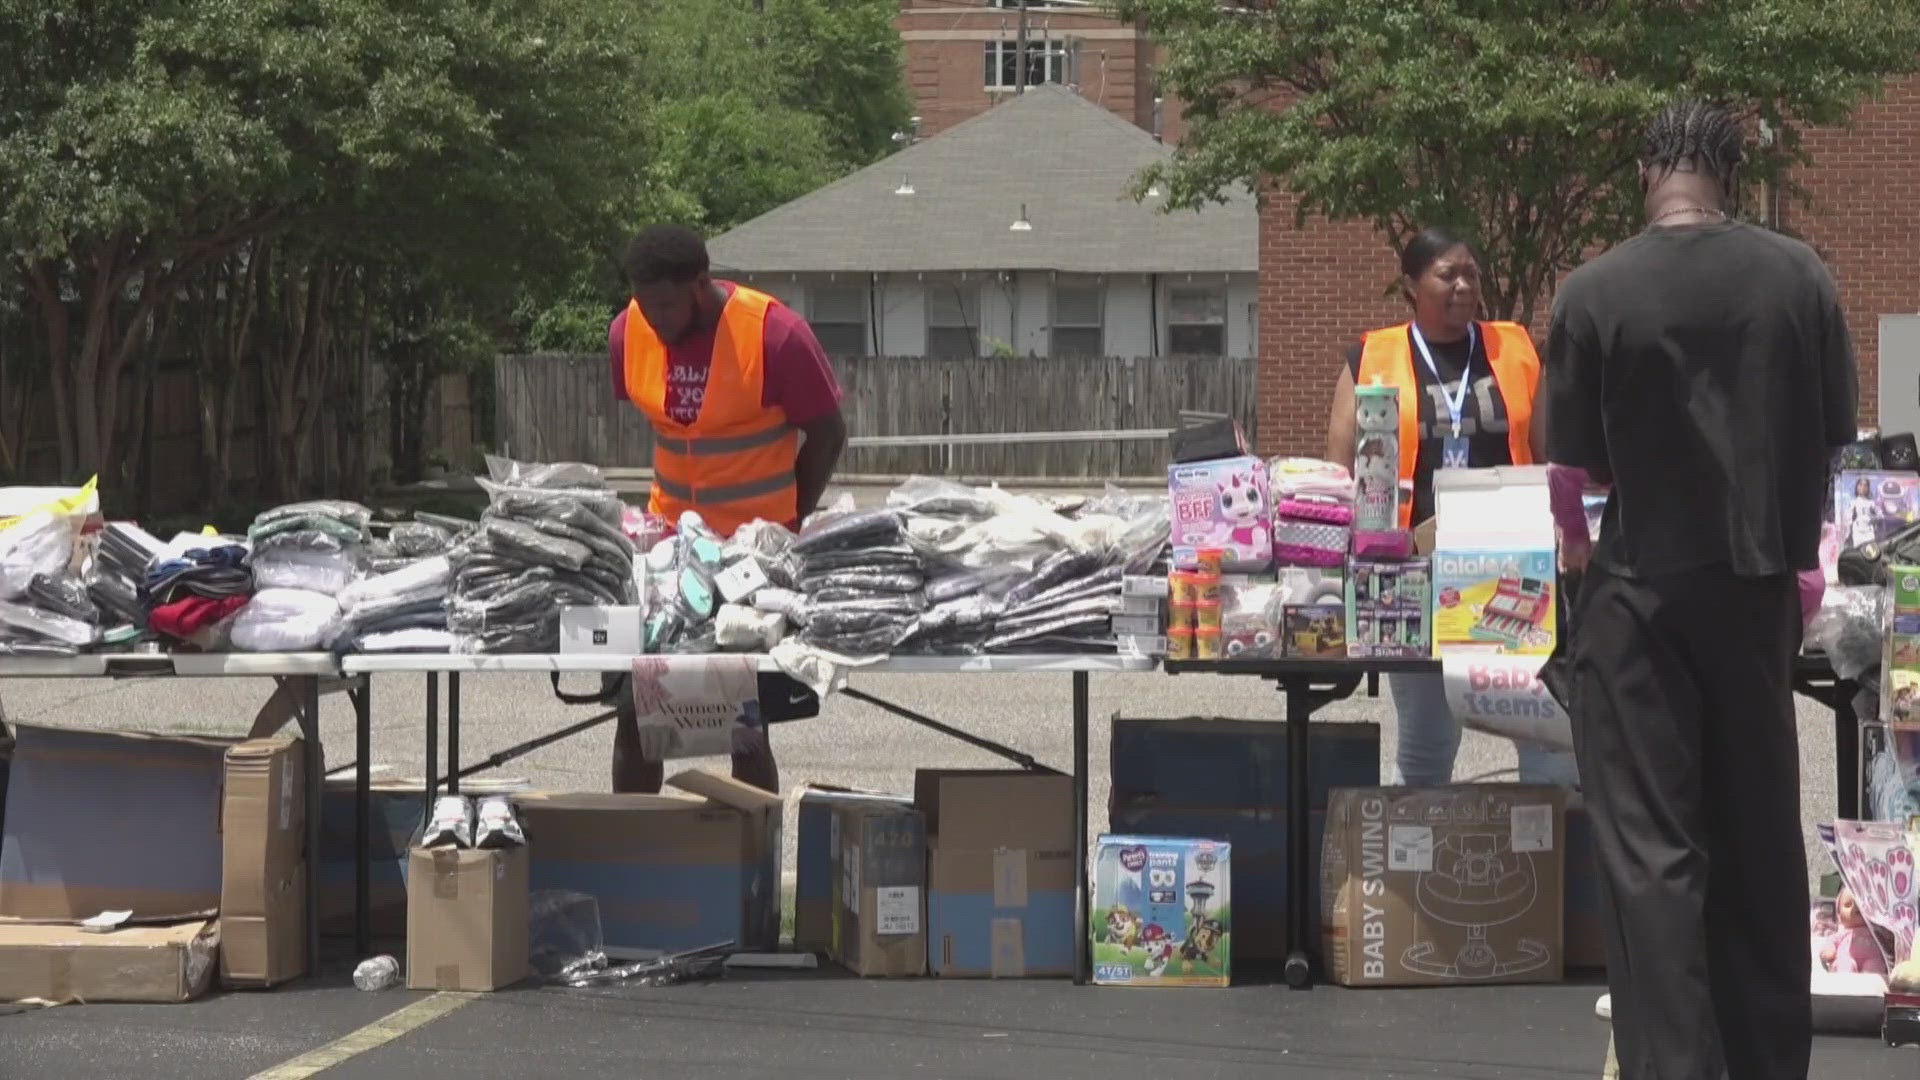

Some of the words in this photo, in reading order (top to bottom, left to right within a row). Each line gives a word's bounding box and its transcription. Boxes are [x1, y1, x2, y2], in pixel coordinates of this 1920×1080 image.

[1178, 498, 1213, 521] BFF
[658, 700, 738, 717] Women's
[1464, 692, 1555, 718] Items
[674, 714, 726, 730] Wear
[1361, 799, 1385, 897] SWING
[1362, 904, 1385, 979] BABY
[1098, 965, 1130, 977] 4T/5T
